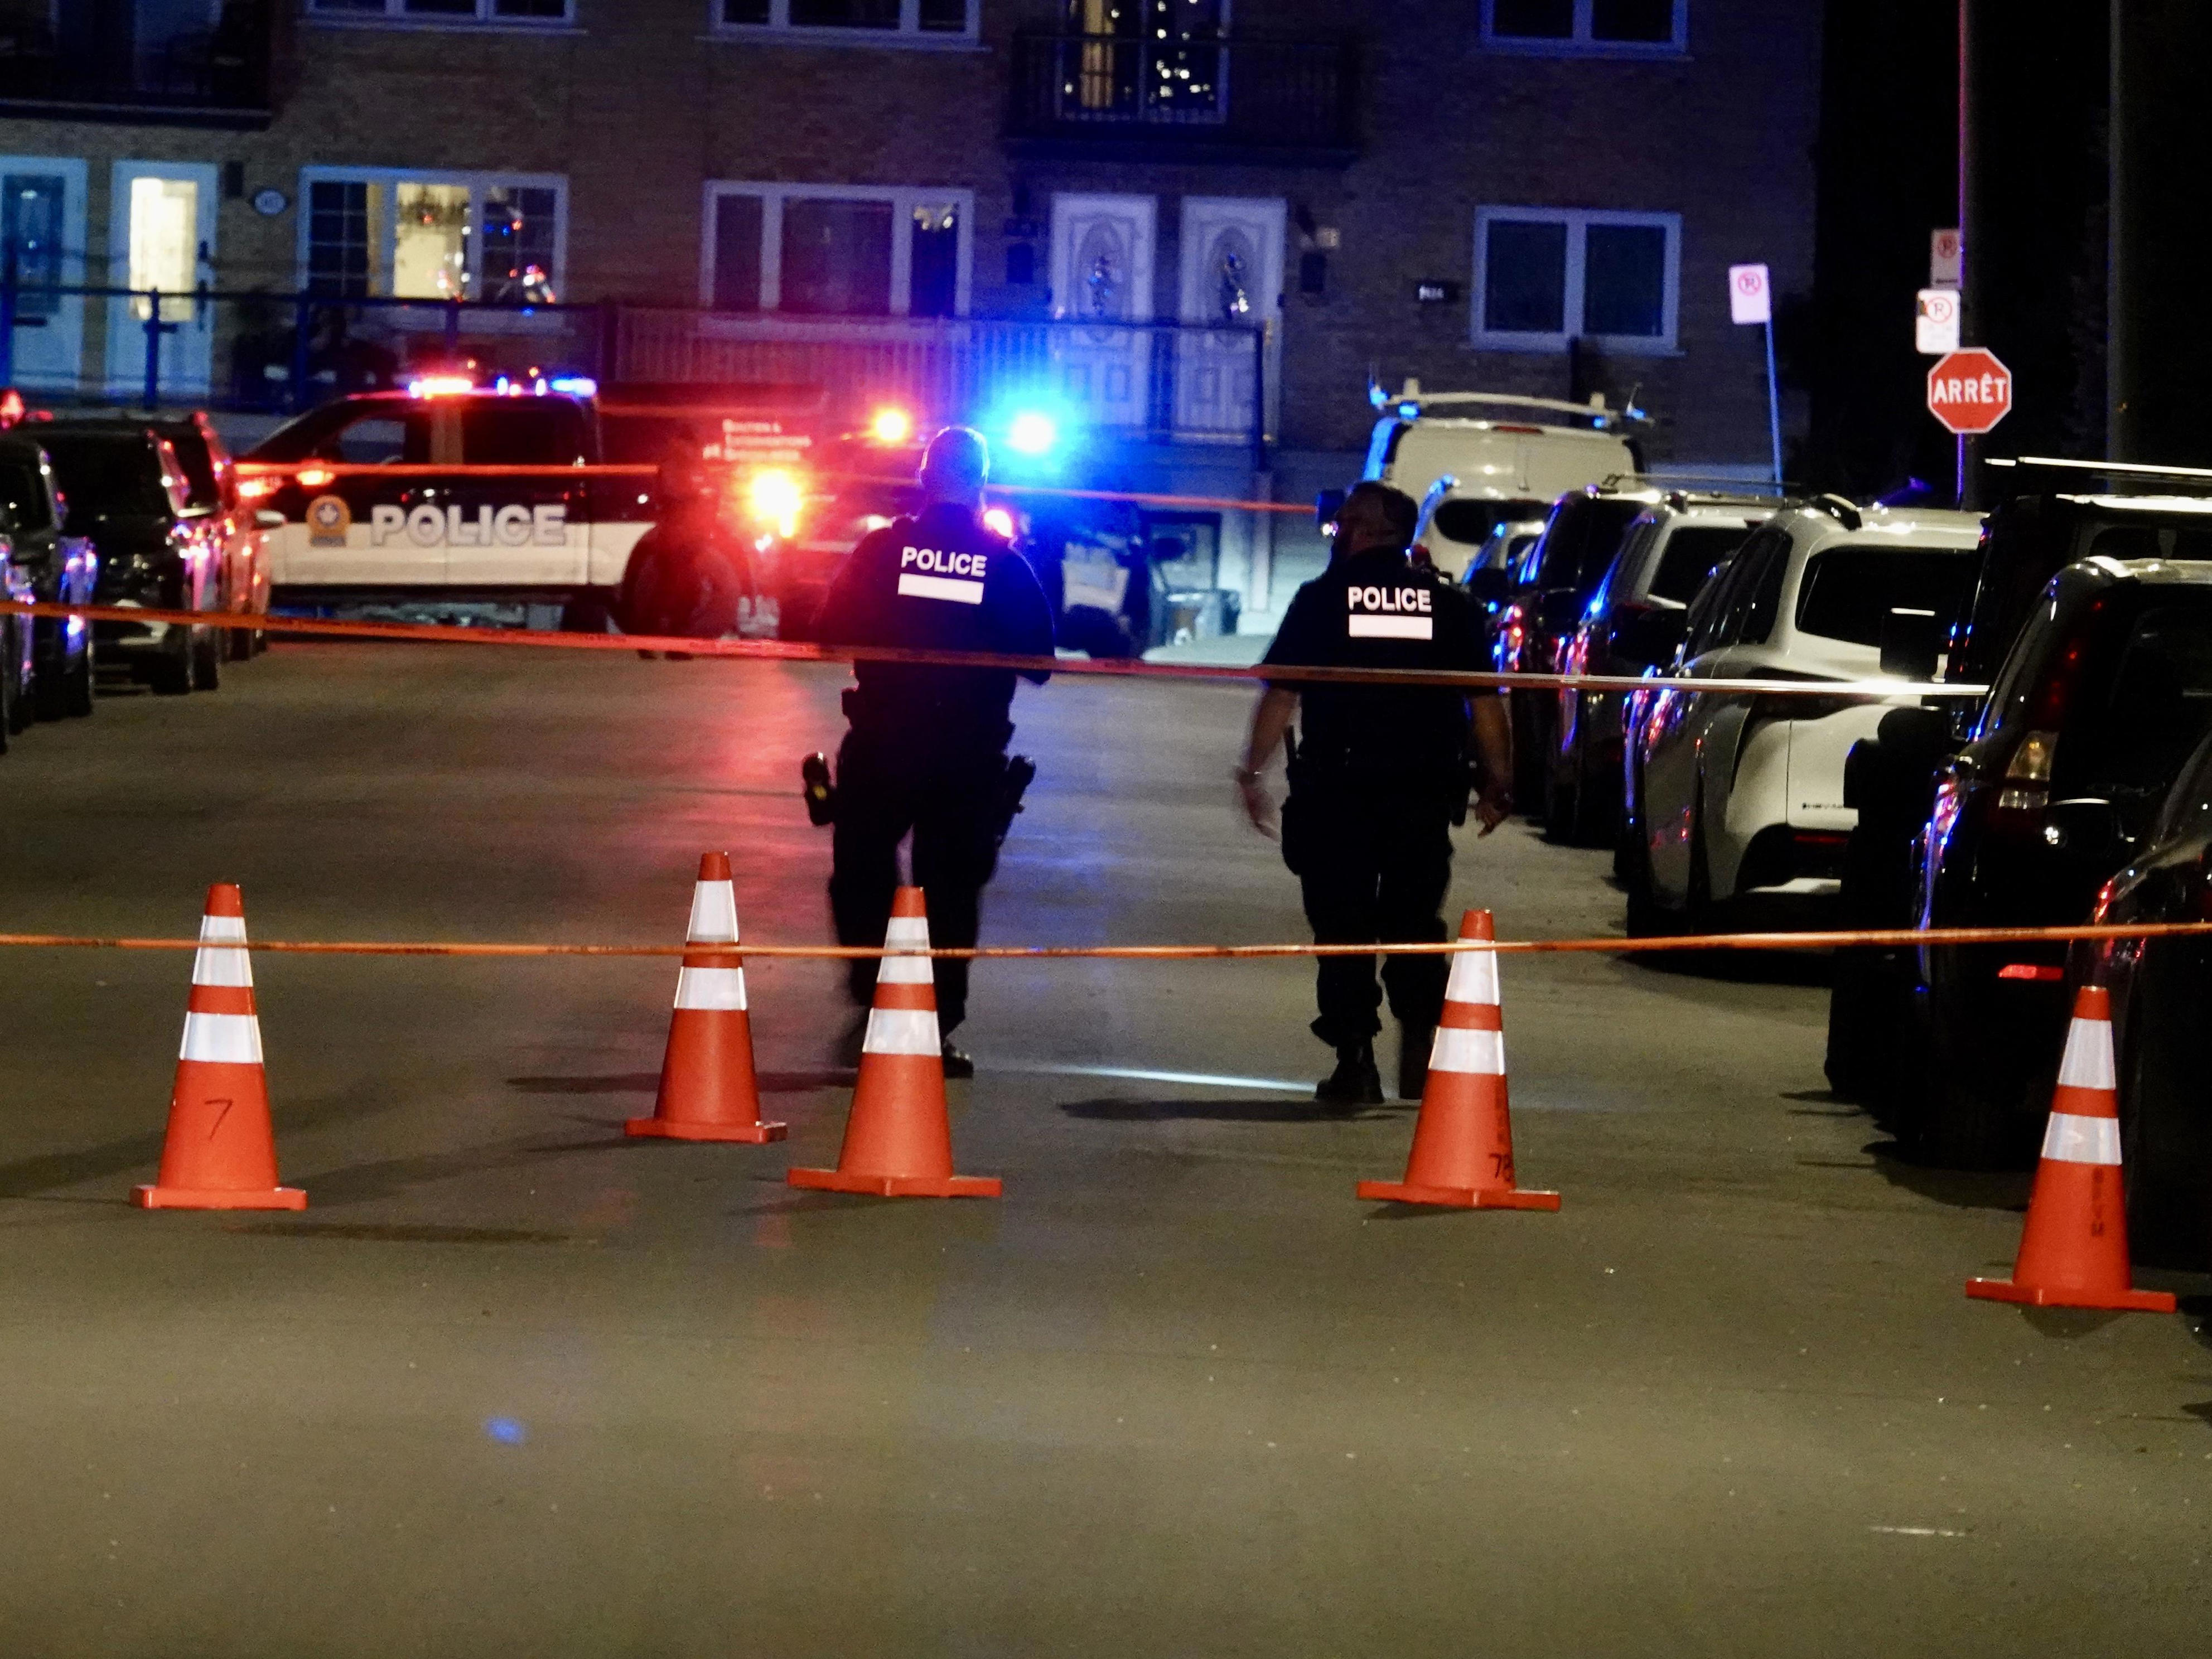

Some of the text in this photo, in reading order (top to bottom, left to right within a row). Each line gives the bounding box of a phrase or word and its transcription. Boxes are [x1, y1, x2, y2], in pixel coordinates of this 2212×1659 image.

[1933, 370, 2007, 404] ARRÊT
[370, 504, 568, 546] POLICE
[901, 546, 987, 577] POLICE
[1348, 587, 1432, 612] POLICE
[204, 1099, 234, 1141] 7
